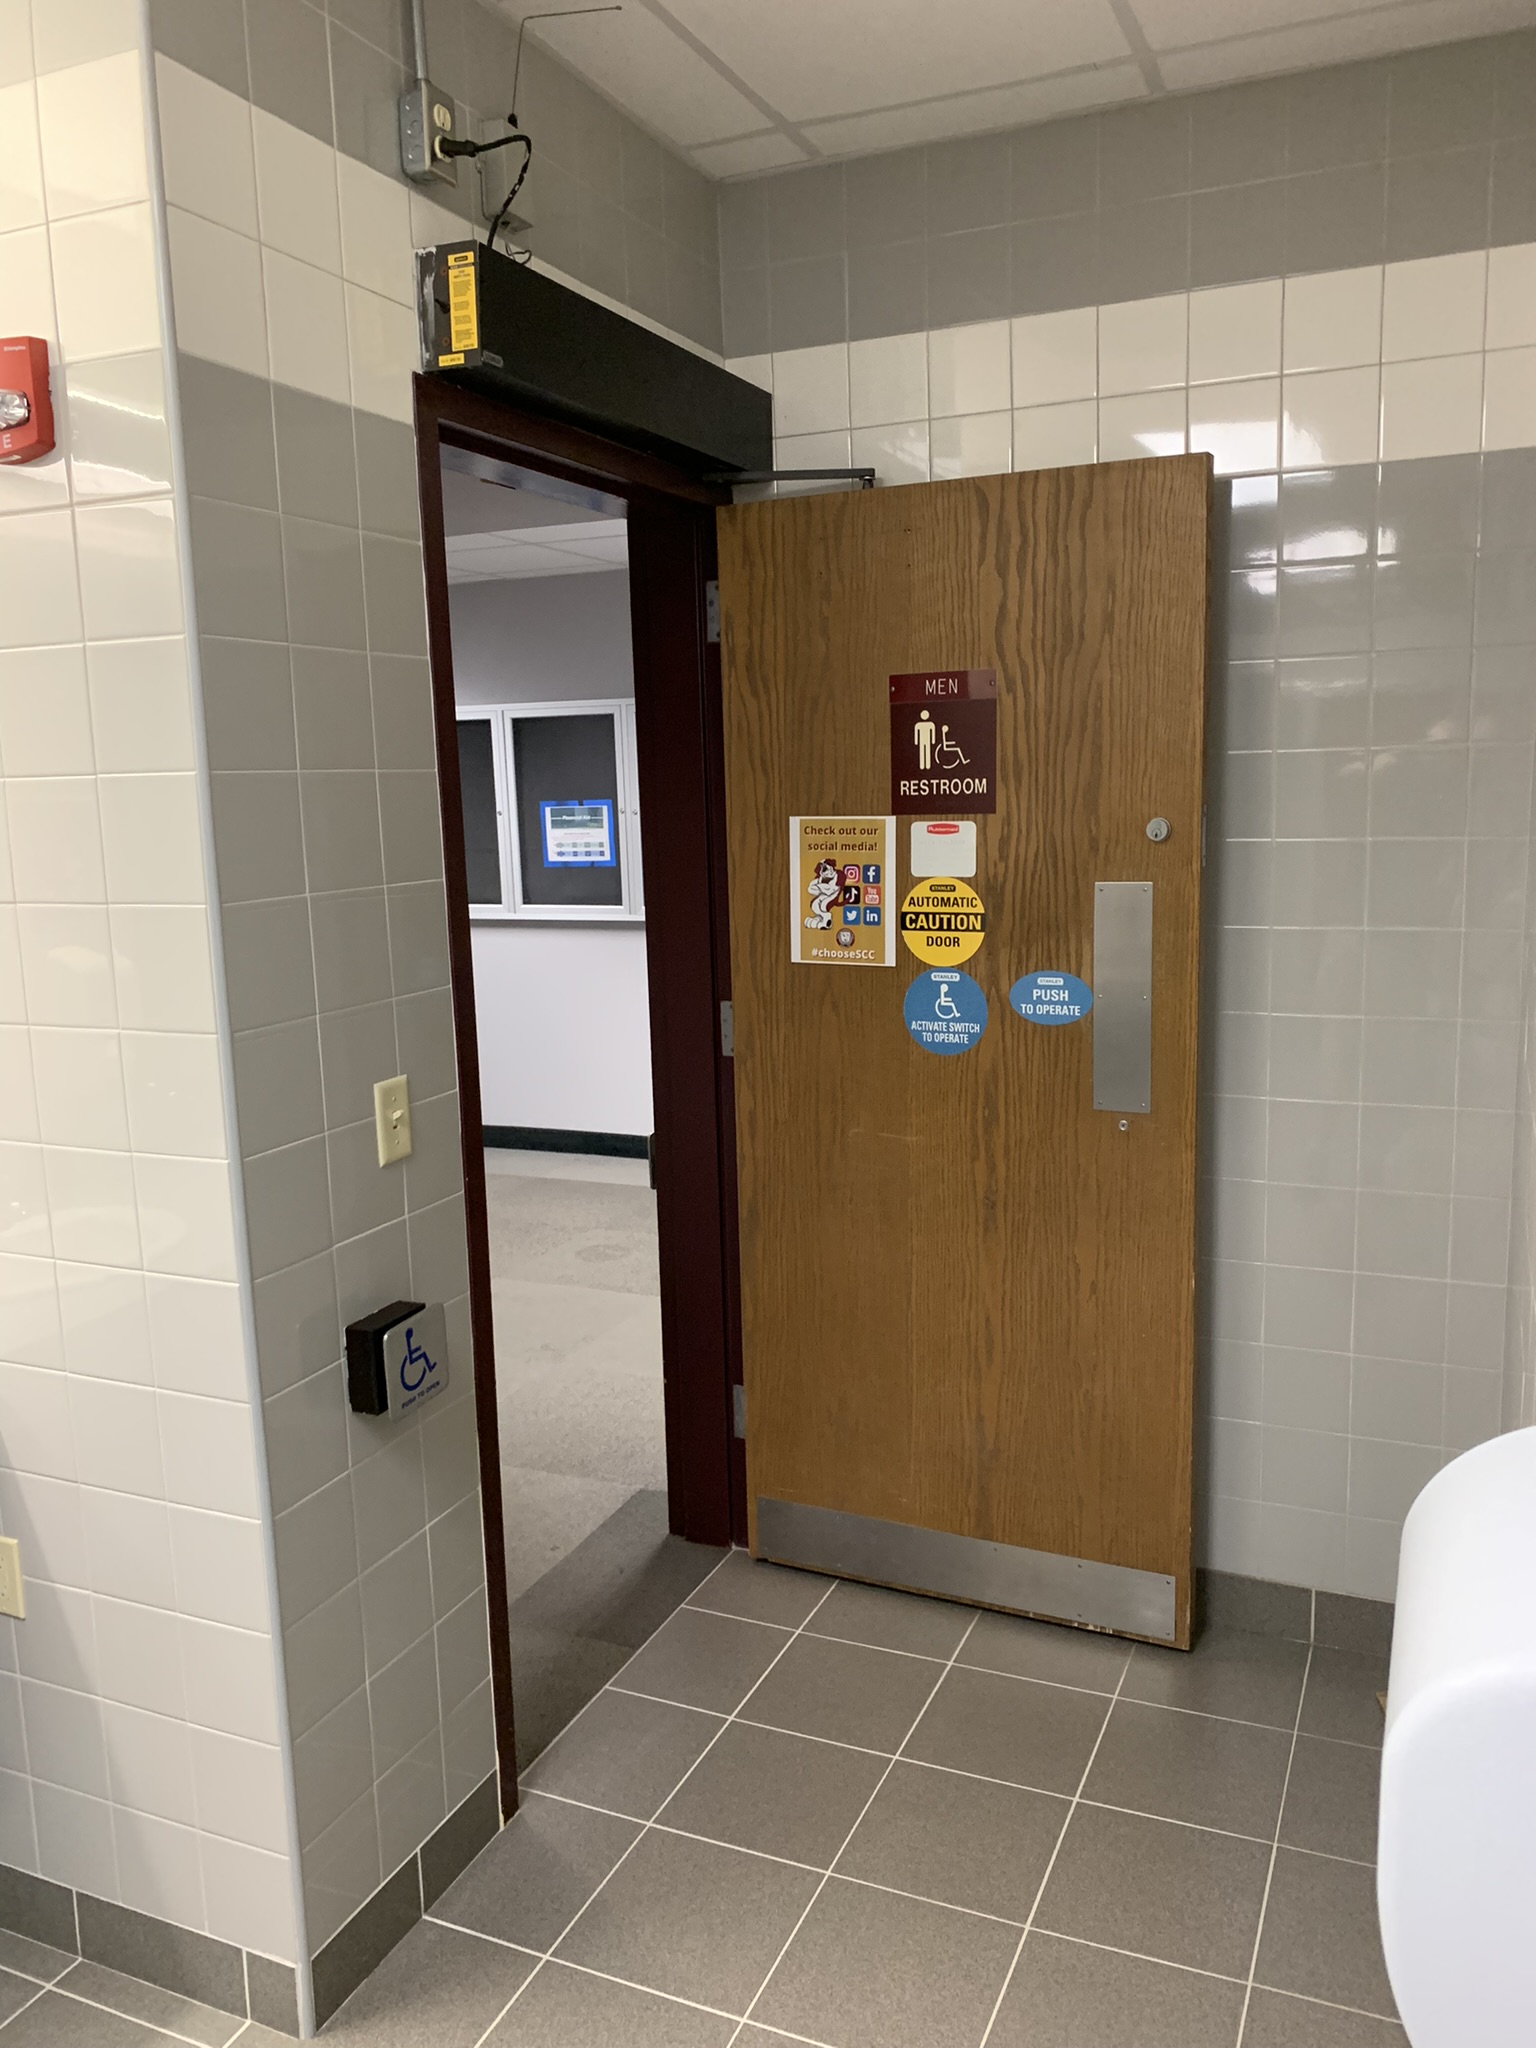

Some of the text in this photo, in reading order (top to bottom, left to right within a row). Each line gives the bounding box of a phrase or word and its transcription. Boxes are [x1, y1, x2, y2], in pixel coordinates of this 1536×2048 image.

[925, 678, 958, 695] MEN
[900, 778, 987, 796] RESTROOM
[804, 826, 879, 836] Check out our
[807, 841, 878, 851] social media!
[908, 896, 978, 909] AUTOMATIC
[866, 910, 878, 922] in
[905, 913, 982, 930] CAUTION
[926, 936, 960, 948] DOOR
[811, 948, 875, 960] #chooseSCC
[1032, 989, 1069, 1002] PUSH
[1020, 1003, 1081, 1016] TO OPERATE
[911, 1020, 980, 1033] ACTIVATE SWITCH
[922, 1032, 969, 1044] TO OPERATE
